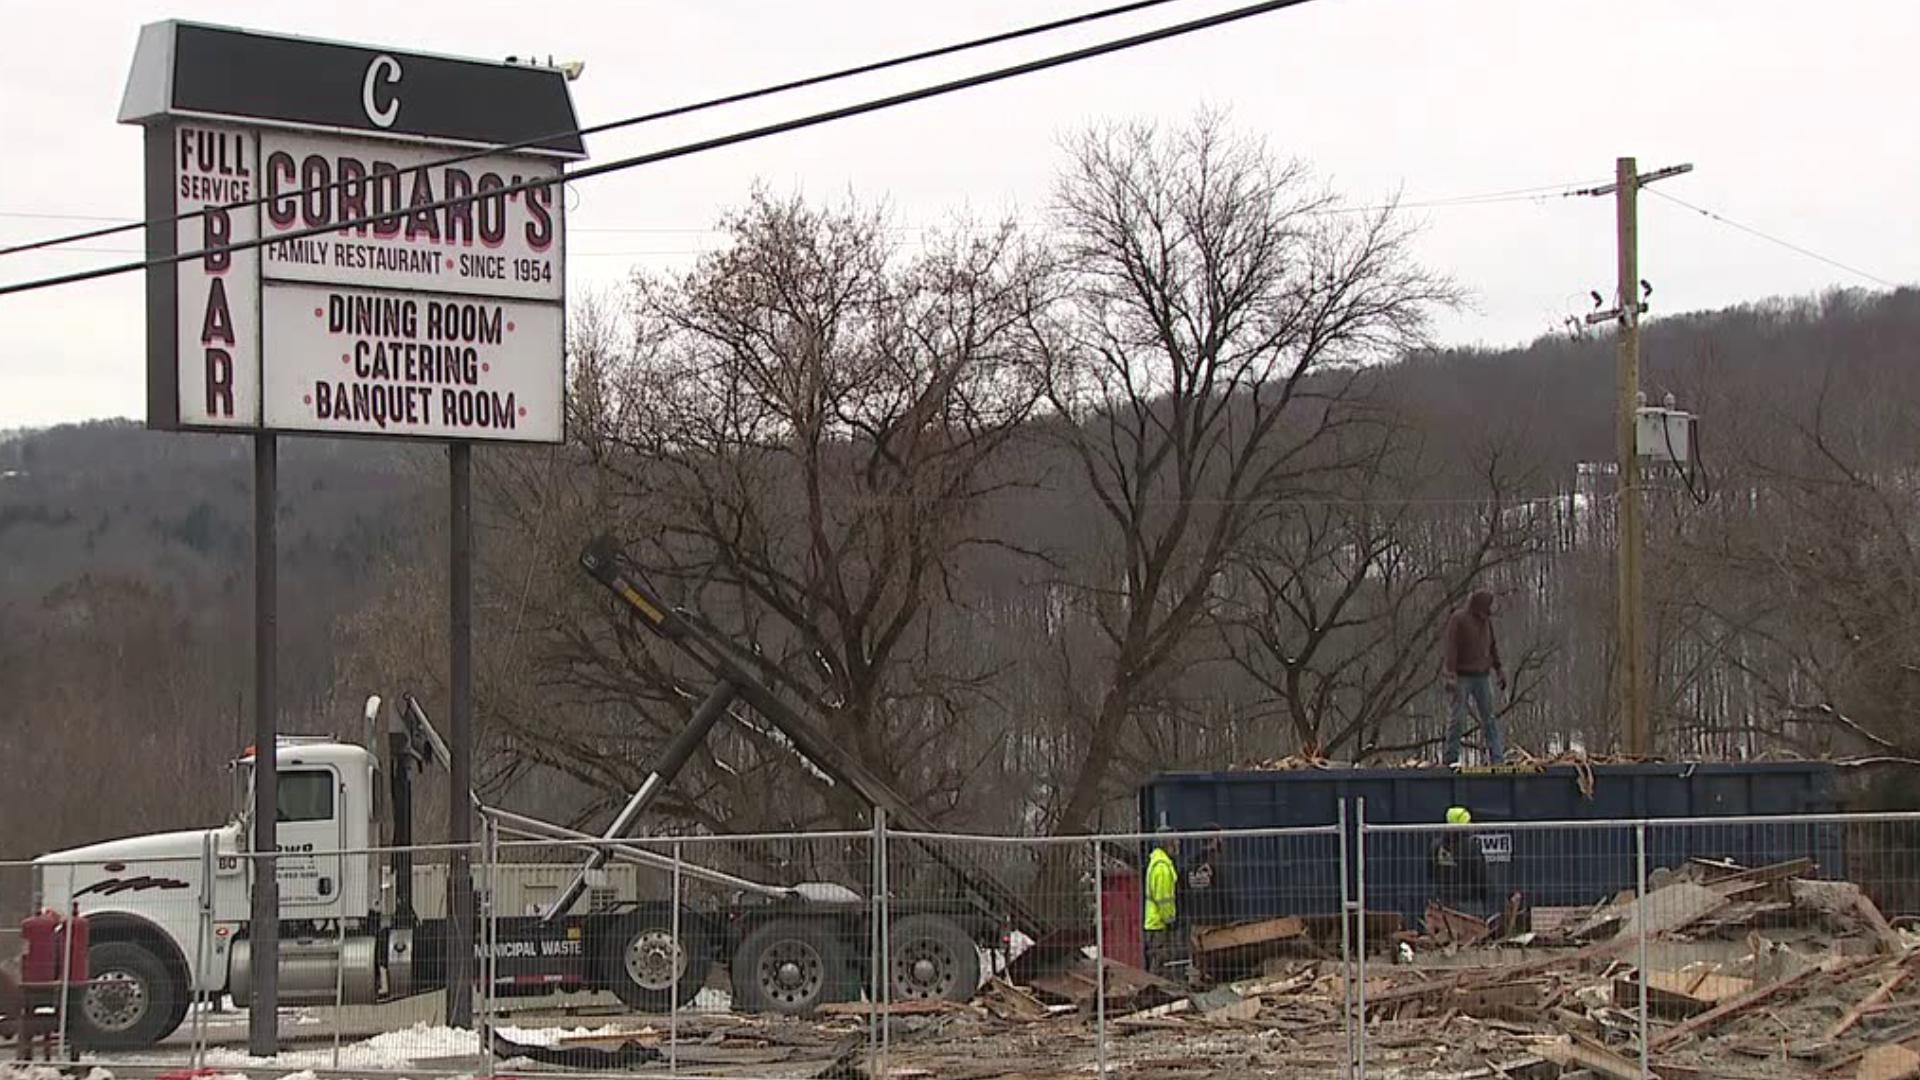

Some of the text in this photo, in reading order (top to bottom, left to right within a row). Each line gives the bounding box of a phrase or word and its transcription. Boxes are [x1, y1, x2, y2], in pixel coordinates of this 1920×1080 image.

[363, 54, 402, 128] C
[180, 128, 249, 177] FULL
[181, 175, 249, 202] SERVICE
[266, 151, 553, 253] CORDARO'S
[268, 239, 552, 283] FAMILY RESTAURANT SINCE 1954
[202, 204, 236, 418] BAR
[329, 294, 501, 345] DINING ROOM
[355, 340, 477, 386] CATERING
[316, 381, 516, 430] BANQUET ROOM
[474, 940, 583, 959] MUNICIPAL WASTE
